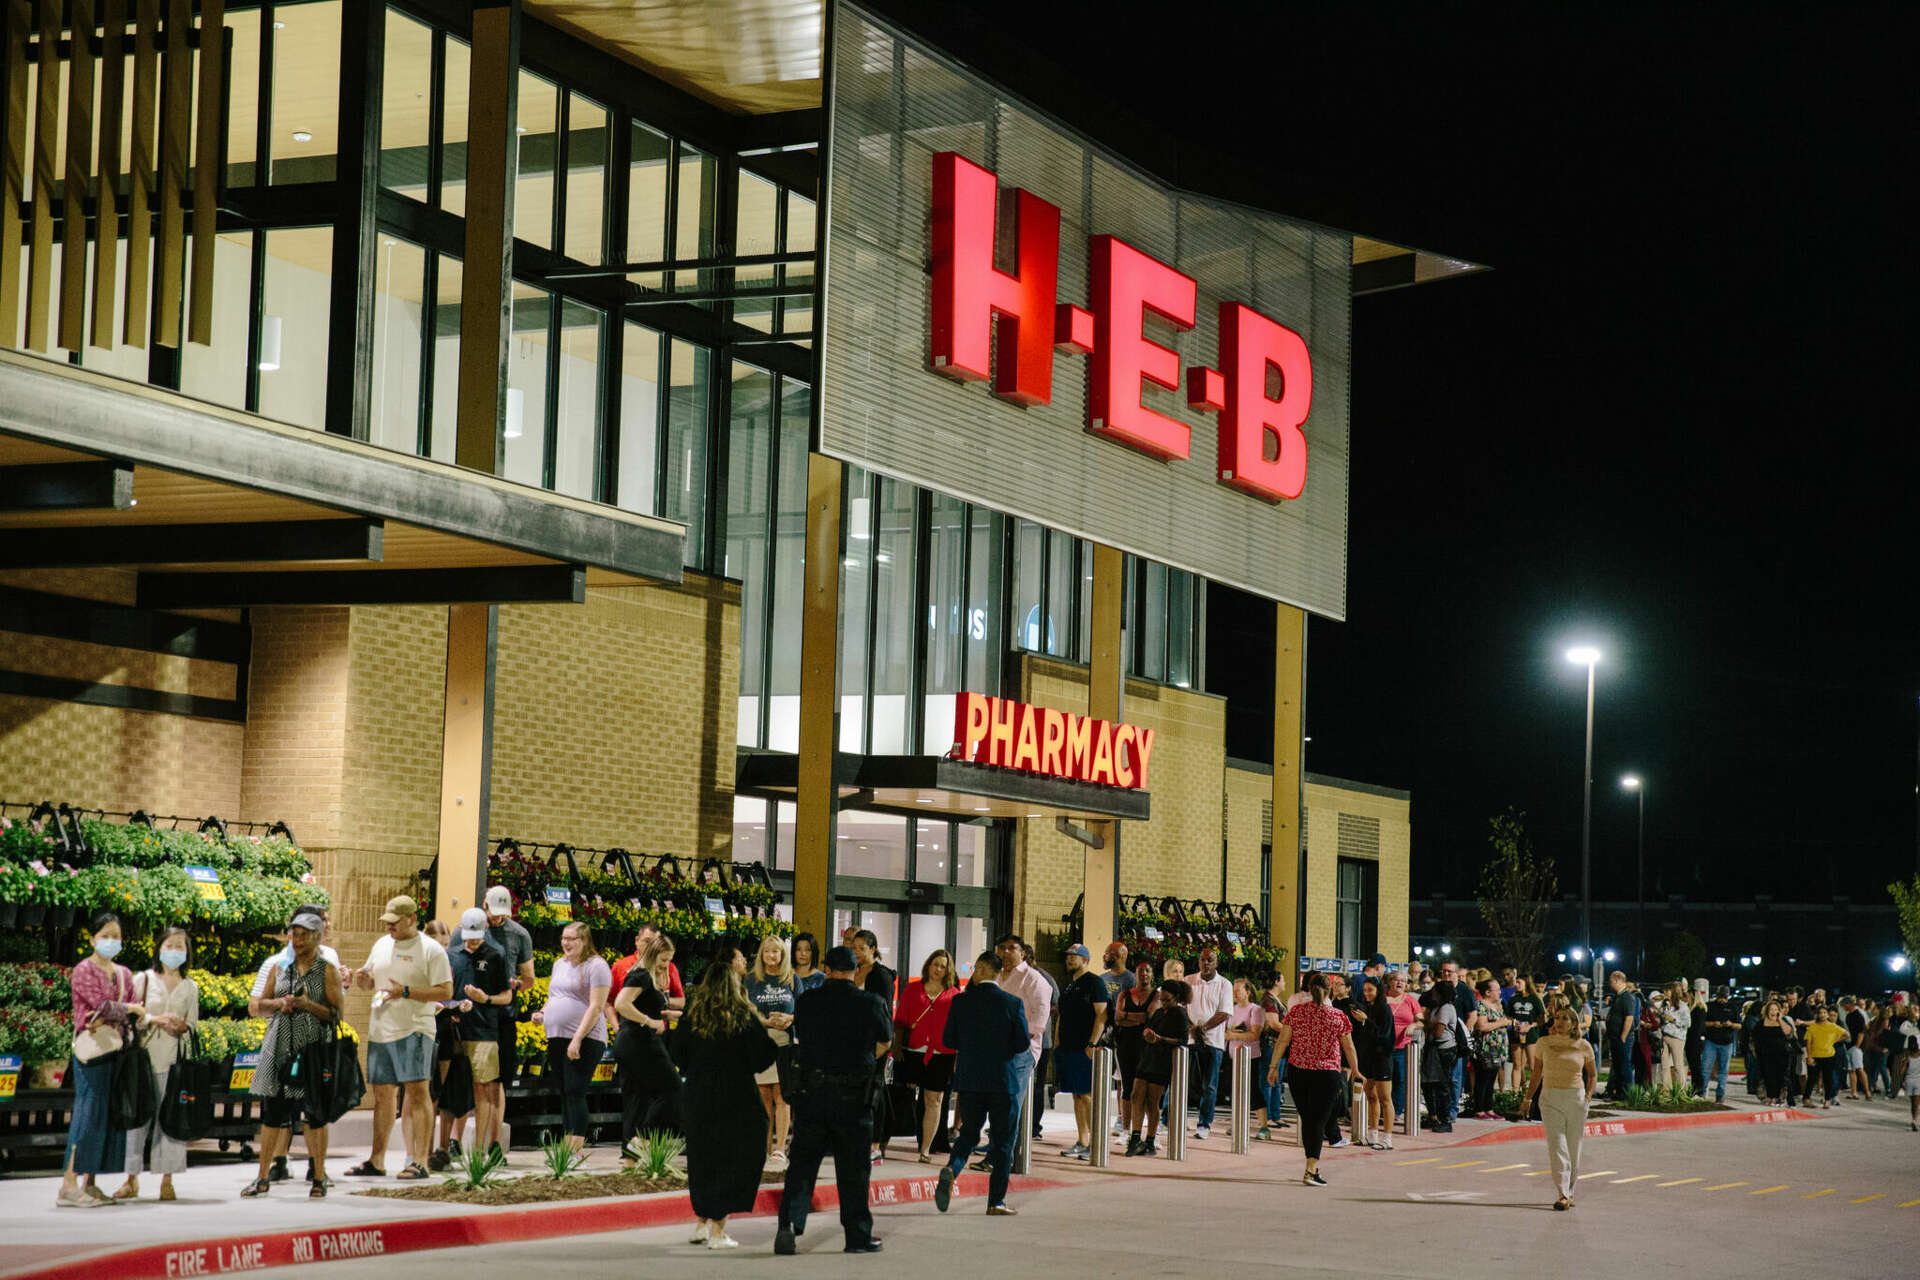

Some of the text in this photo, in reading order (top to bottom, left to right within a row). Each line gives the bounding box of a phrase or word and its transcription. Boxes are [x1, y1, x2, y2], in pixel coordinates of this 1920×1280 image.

[932, 151, 1313, 500] H-E-B
[957, 691, 1156, 790] PHARMACY
[871, 1184, 898, 1204] LANE
[909, 1181, 922, 1201] NO
[165, 1230, 384, 1278] FIRE LANE NO PARKING
